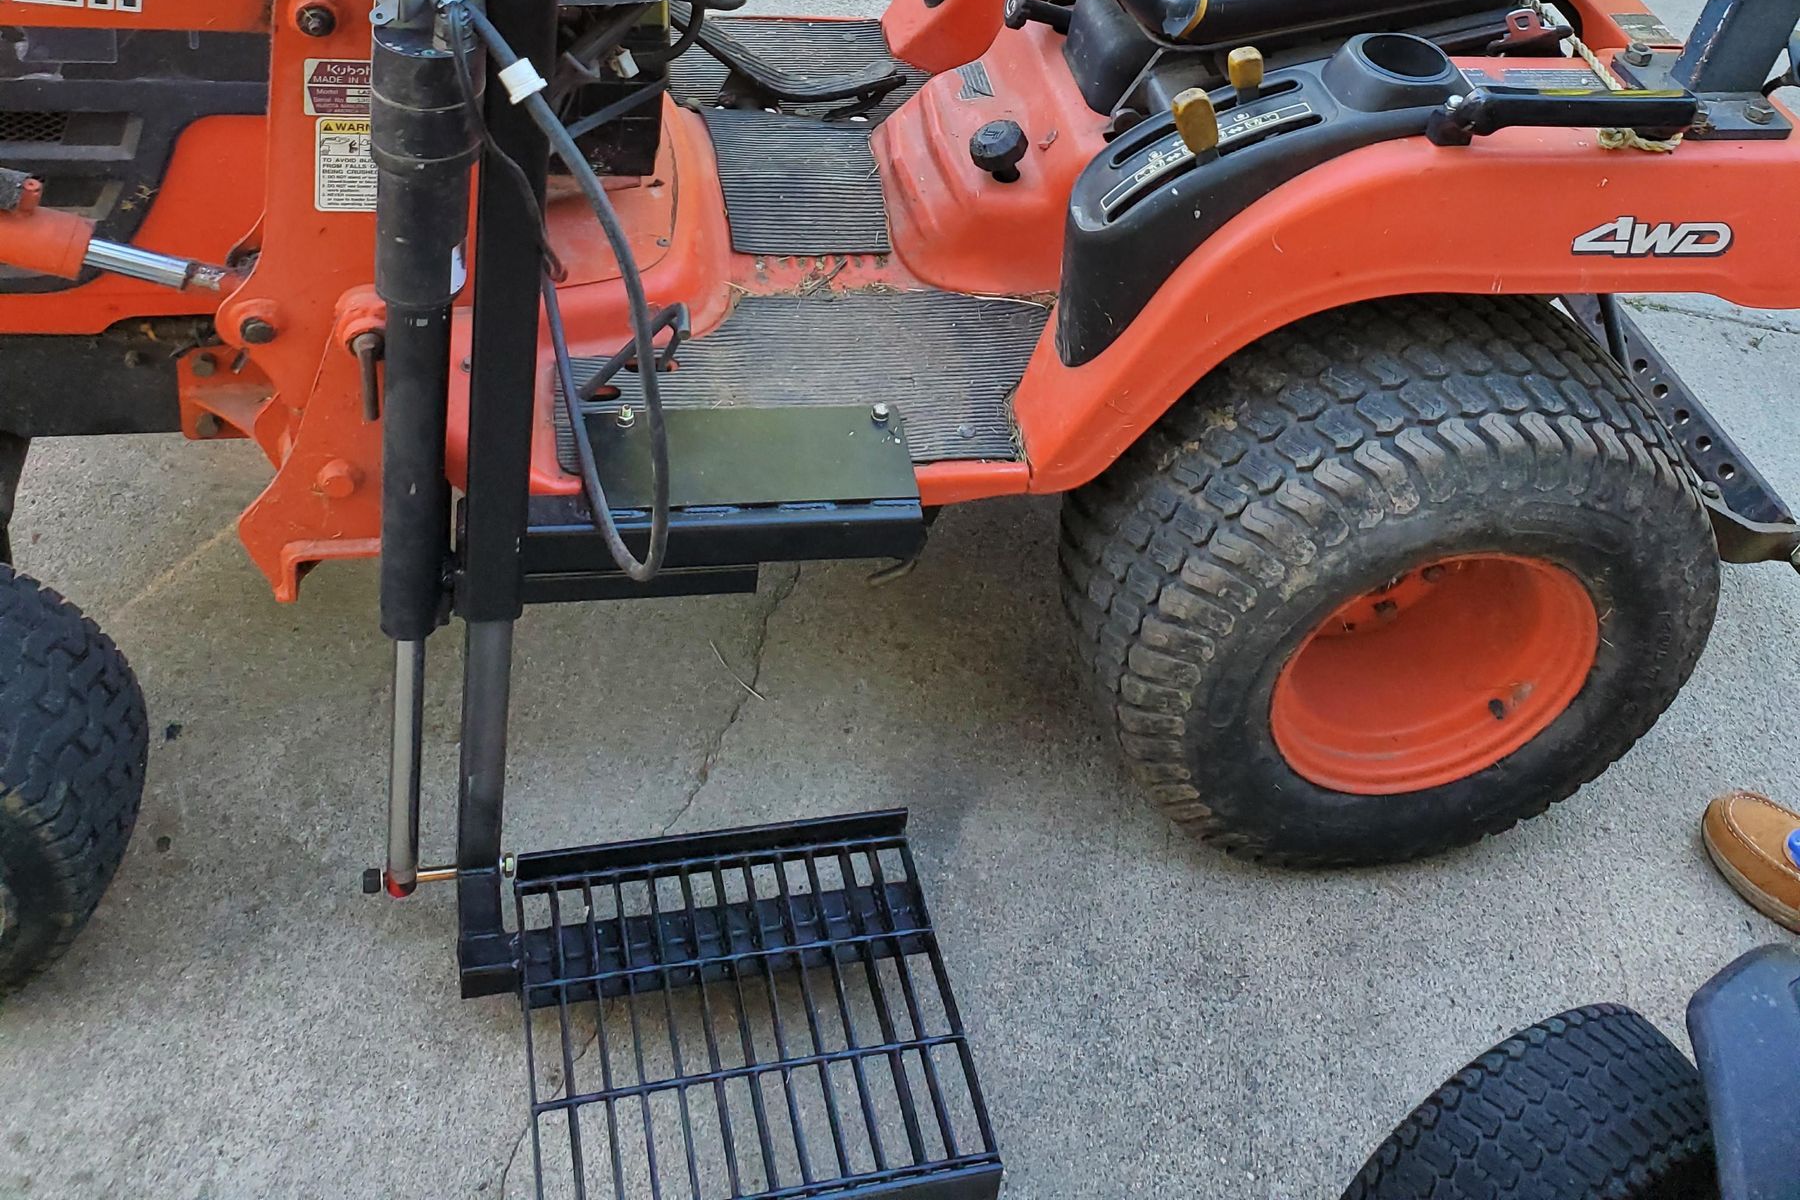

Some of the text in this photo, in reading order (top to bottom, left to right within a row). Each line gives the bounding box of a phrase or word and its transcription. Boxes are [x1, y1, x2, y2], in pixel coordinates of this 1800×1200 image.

[326, 64, 371, 75] Kubot
[312, 76, 343, 84] MADE
[335, 122, 371, 132] WARN
[1572, 216, 1734, 257] 4WD
